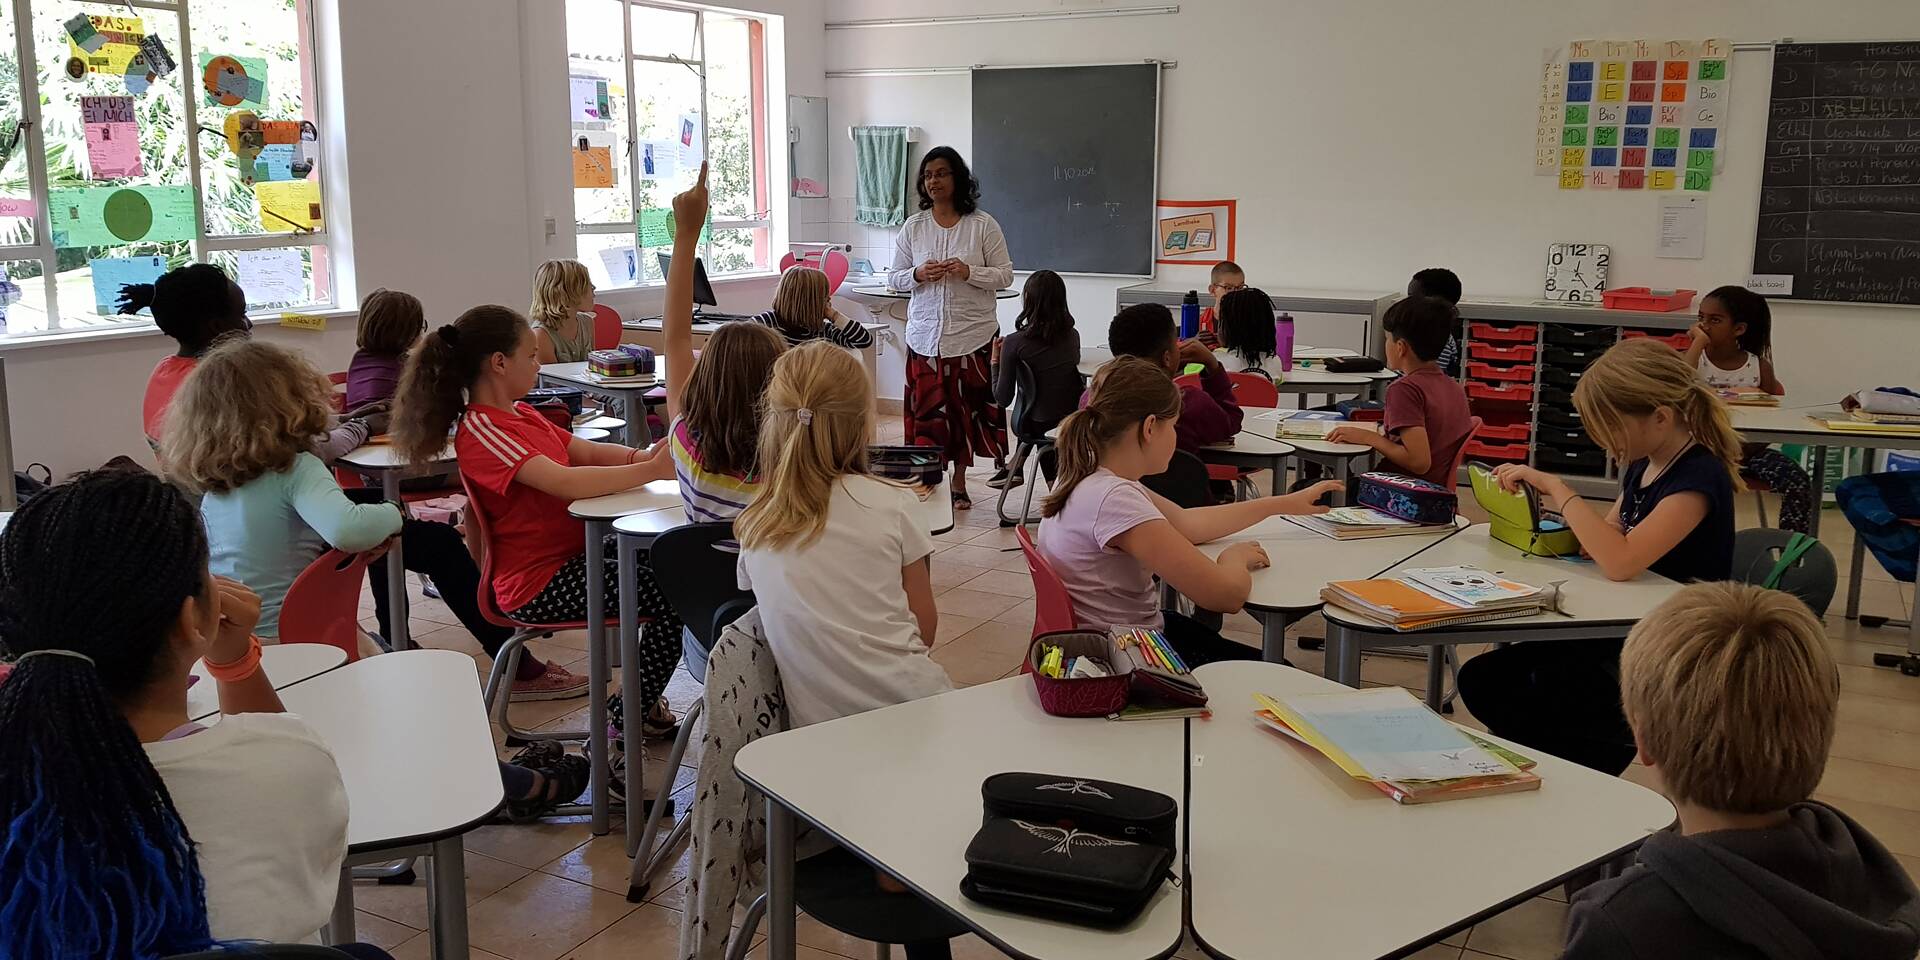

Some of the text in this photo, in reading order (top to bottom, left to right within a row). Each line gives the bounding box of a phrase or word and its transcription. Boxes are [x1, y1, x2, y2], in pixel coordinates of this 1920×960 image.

[1572, 41, 1590, 58] Mo
[1704, 39, 1720, 56] Fr
[1606, 63, 1617, 80] E
[1604, 84, 1617, 100] E
[1700, 86, 1717, 99] Bio
[82, 97, 102, 108] ICH
[1599, 107, 1616, 121] Bio
[1593, 170, 1607, 185] KL
[1654, 170, 1665, 186] E
[1569, 244, 1587, 256] 12
[1597, 254, 1609, 266] 2
[1596, 267, 1606, 279] 3
[1545, 279, 1556, 291] 8
[1594, 280, 1606, 292] 4
[1556, 289, 1567, 300] 7
[1569, 289, 1581, 301] 6
[1583, 290, 1594, 301] 5
